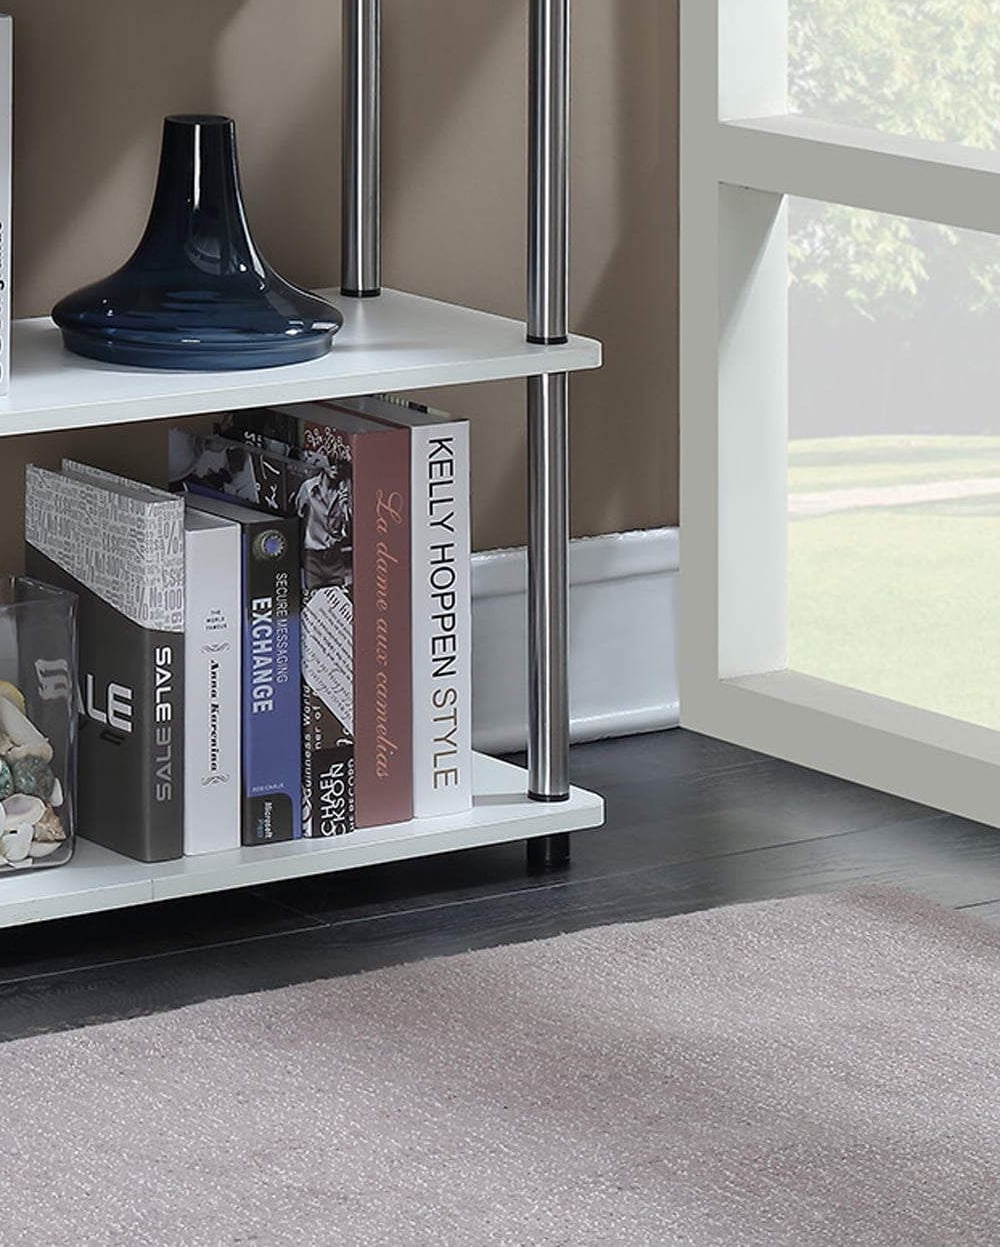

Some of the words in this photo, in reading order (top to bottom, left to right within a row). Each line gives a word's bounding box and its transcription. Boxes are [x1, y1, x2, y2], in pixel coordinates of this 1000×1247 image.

[375, 488, 403, 534] La
[428, 437, 455, 533] KELLY
[275, 572, 288, 617] SECURE
[375, 541, 399, 611] dame
[375, 617, 389, 666] aux
[429, 546, 457, 678] HOPPEN
[209, 659, 220, 698] Anna
[250, 597, 274, 714] EXCHANGE
[275, 618, 288, 683] MESSAGING
[155, 646, 172, 722] SALE
[302, 685, 311, 726] World
[312, 704, 322, 720] of
[209, 702, 220, 771] Karenina
[302, 732, 312, 798] Guinness
[432, 689, 458, 790] STYLE
[264, 801, 273, 838] Microsoft
